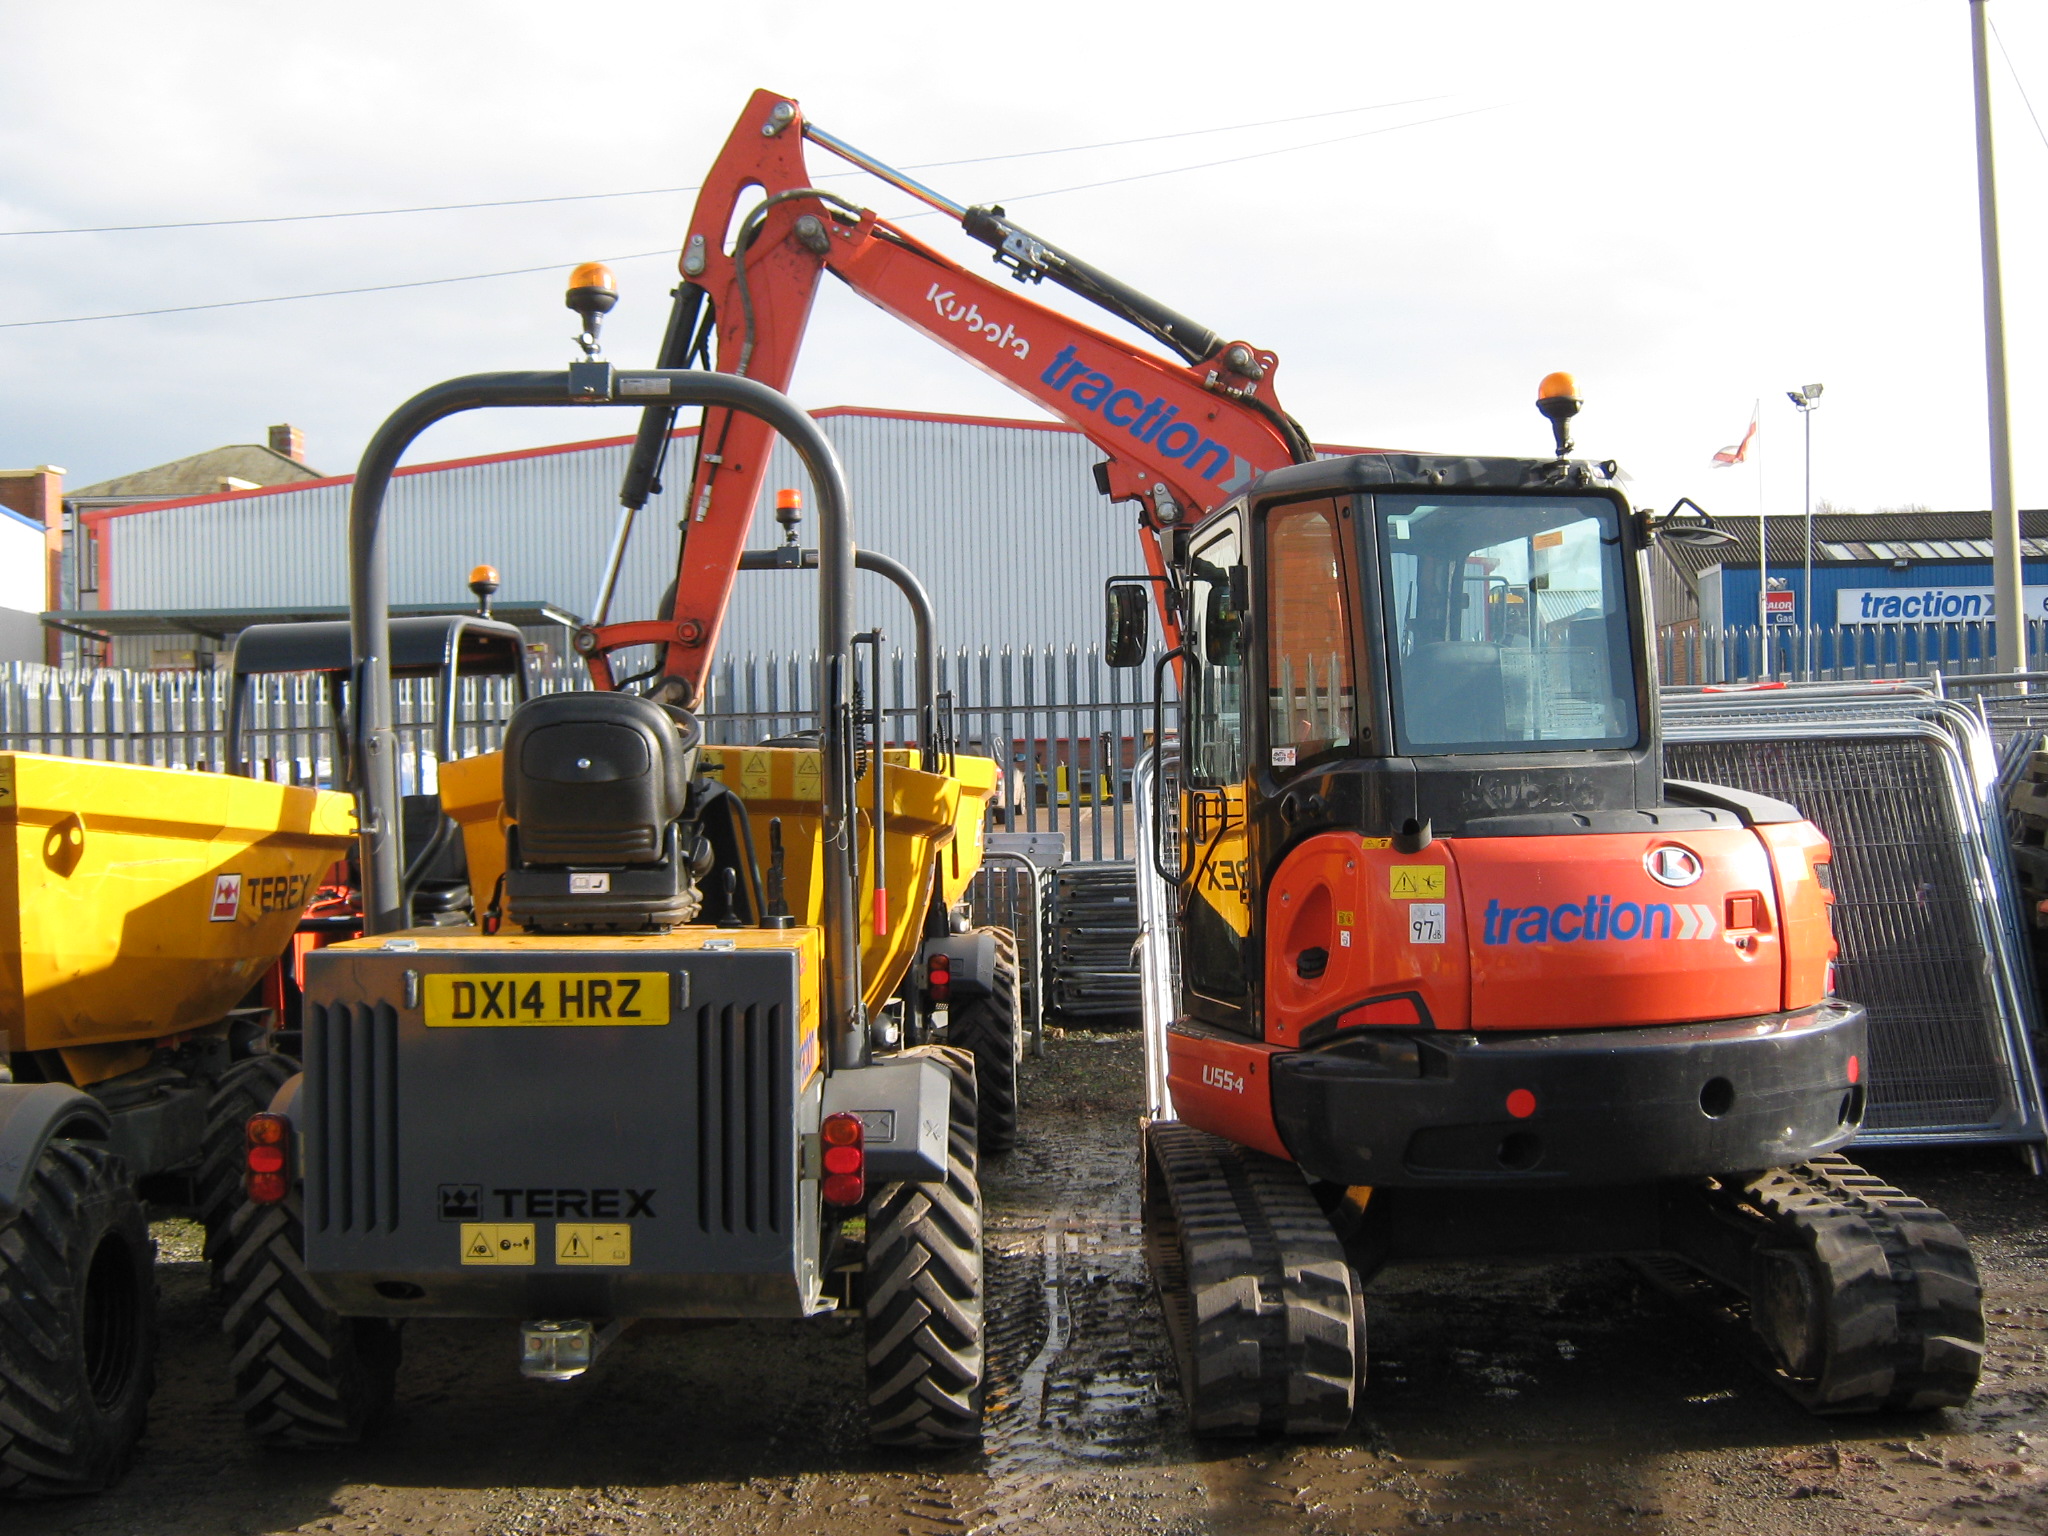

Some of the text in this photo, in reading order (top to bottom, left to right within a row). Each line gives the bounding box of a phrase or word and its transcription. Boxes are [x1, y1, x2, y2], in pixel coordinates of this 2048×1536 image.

[926, 282, 1030, 360] Kubota
[1039, 344, 1231, 481] traction
[1766, 601, 1793, 611] ALOR
[1776, 613, 1793, 623] Gas
[1861, 591, 1982, 619] traction
[1413, 920, 1434, 940] 97
[1483, 895, 1673, 946] traction
[452, 979, 642, 1019] DX14 HRZ
[493, 1189, 657, 1218] TEREX
